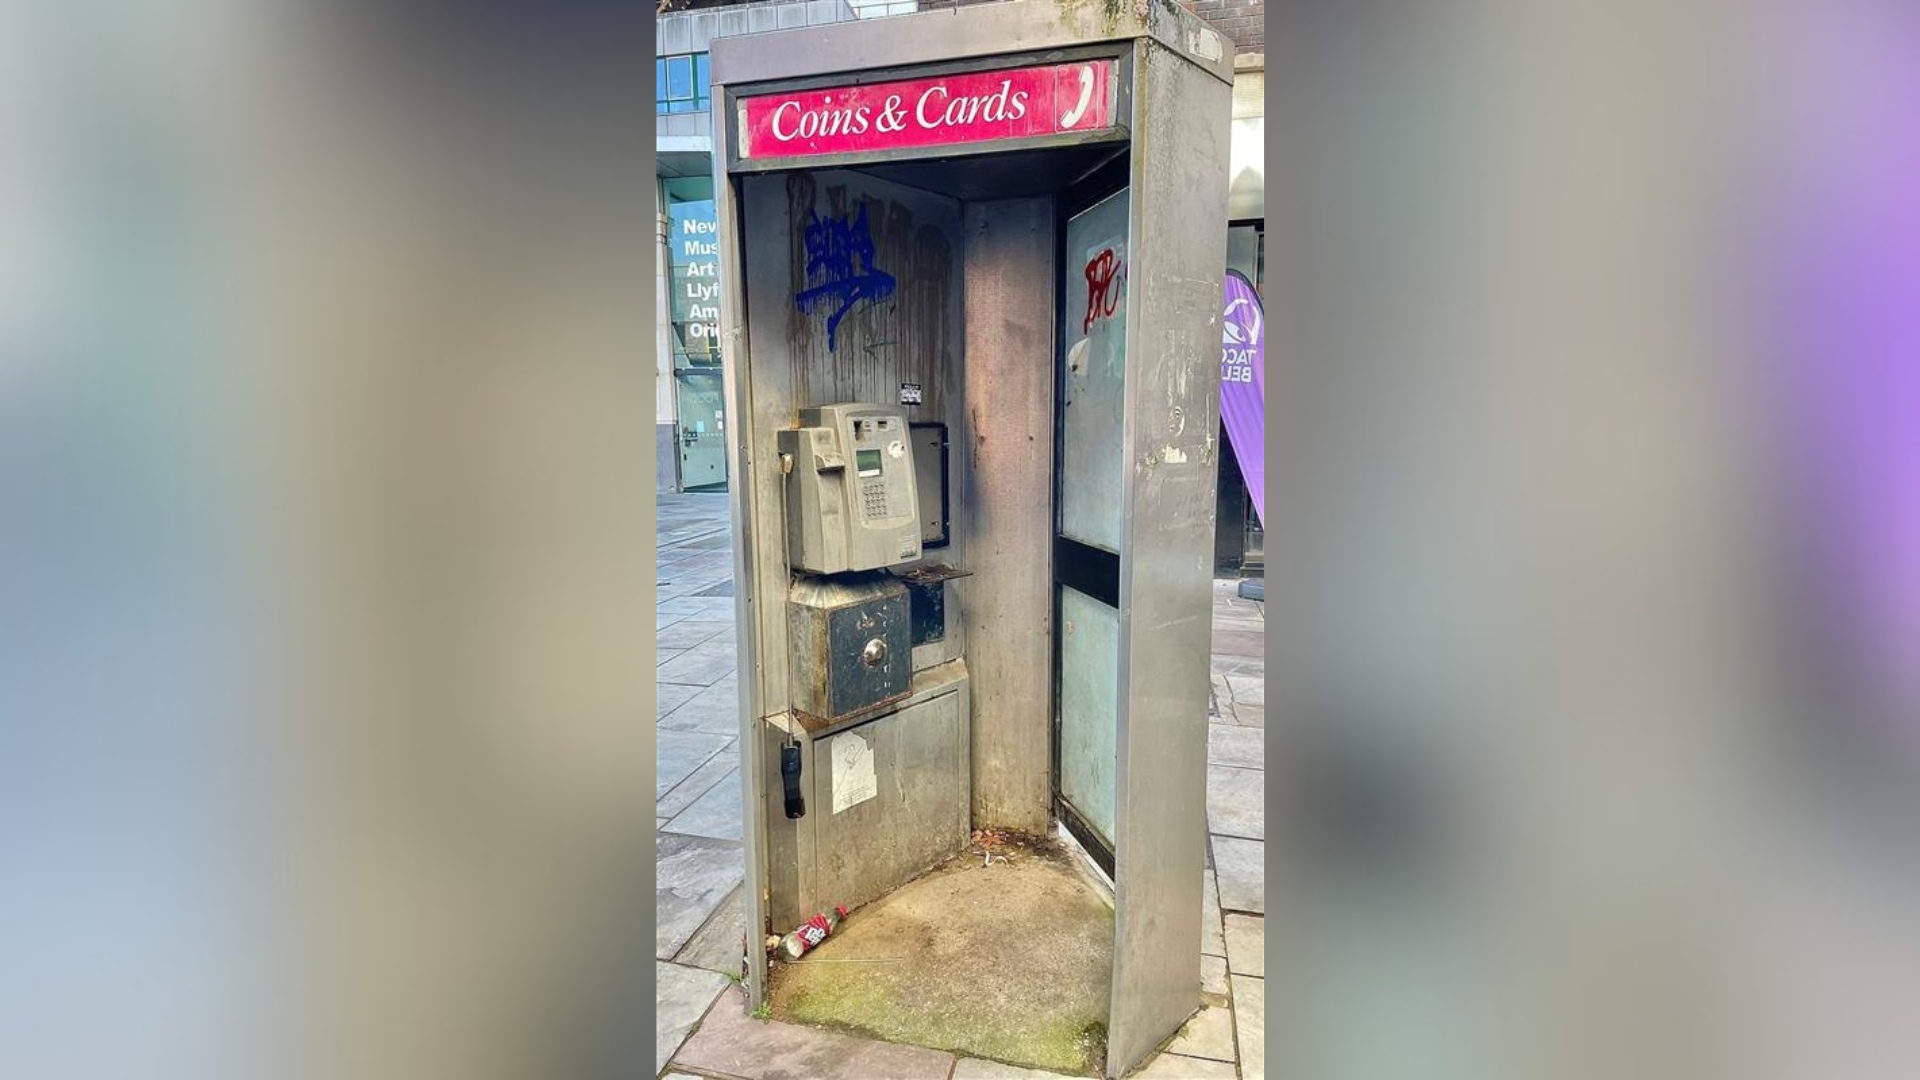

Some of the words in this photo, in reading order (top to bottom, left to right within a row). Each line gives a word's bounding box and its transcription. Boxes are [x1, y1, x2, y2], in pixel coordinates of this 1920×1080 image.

[771, 95, 871, 142] Coins
[875, 94, 907, 134] &
[915, 80, 1029, 129] Cards
